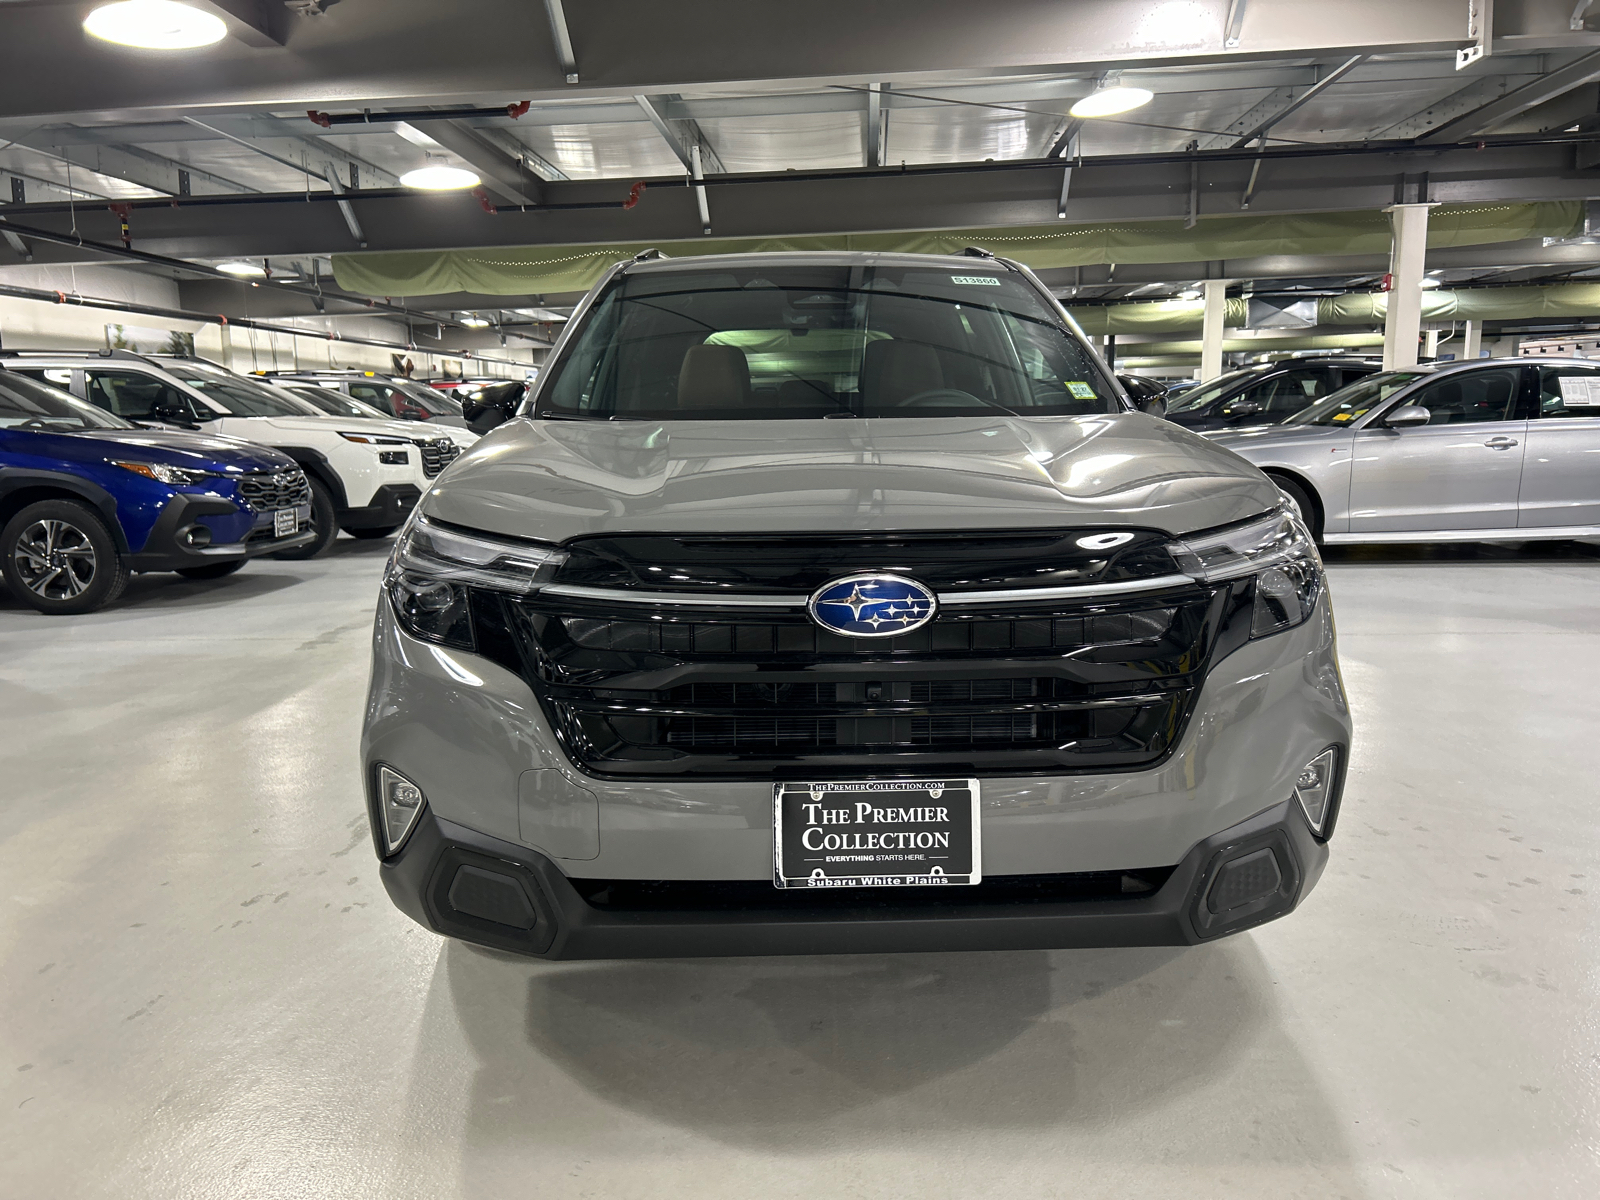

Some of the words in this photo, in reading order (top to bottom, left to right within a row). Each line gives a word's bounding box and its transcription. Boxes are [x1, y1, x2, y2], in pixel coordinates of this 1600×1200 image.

[802, 803, 850, 825] THE
[854, 802, 950, 824] PREMIER
[802, 827, 950, 851] COLLECTION
[807, 877, 856, 887] Subaru
[861, 877, 901, 886] White
[906, 876, 948, 885] Plains
